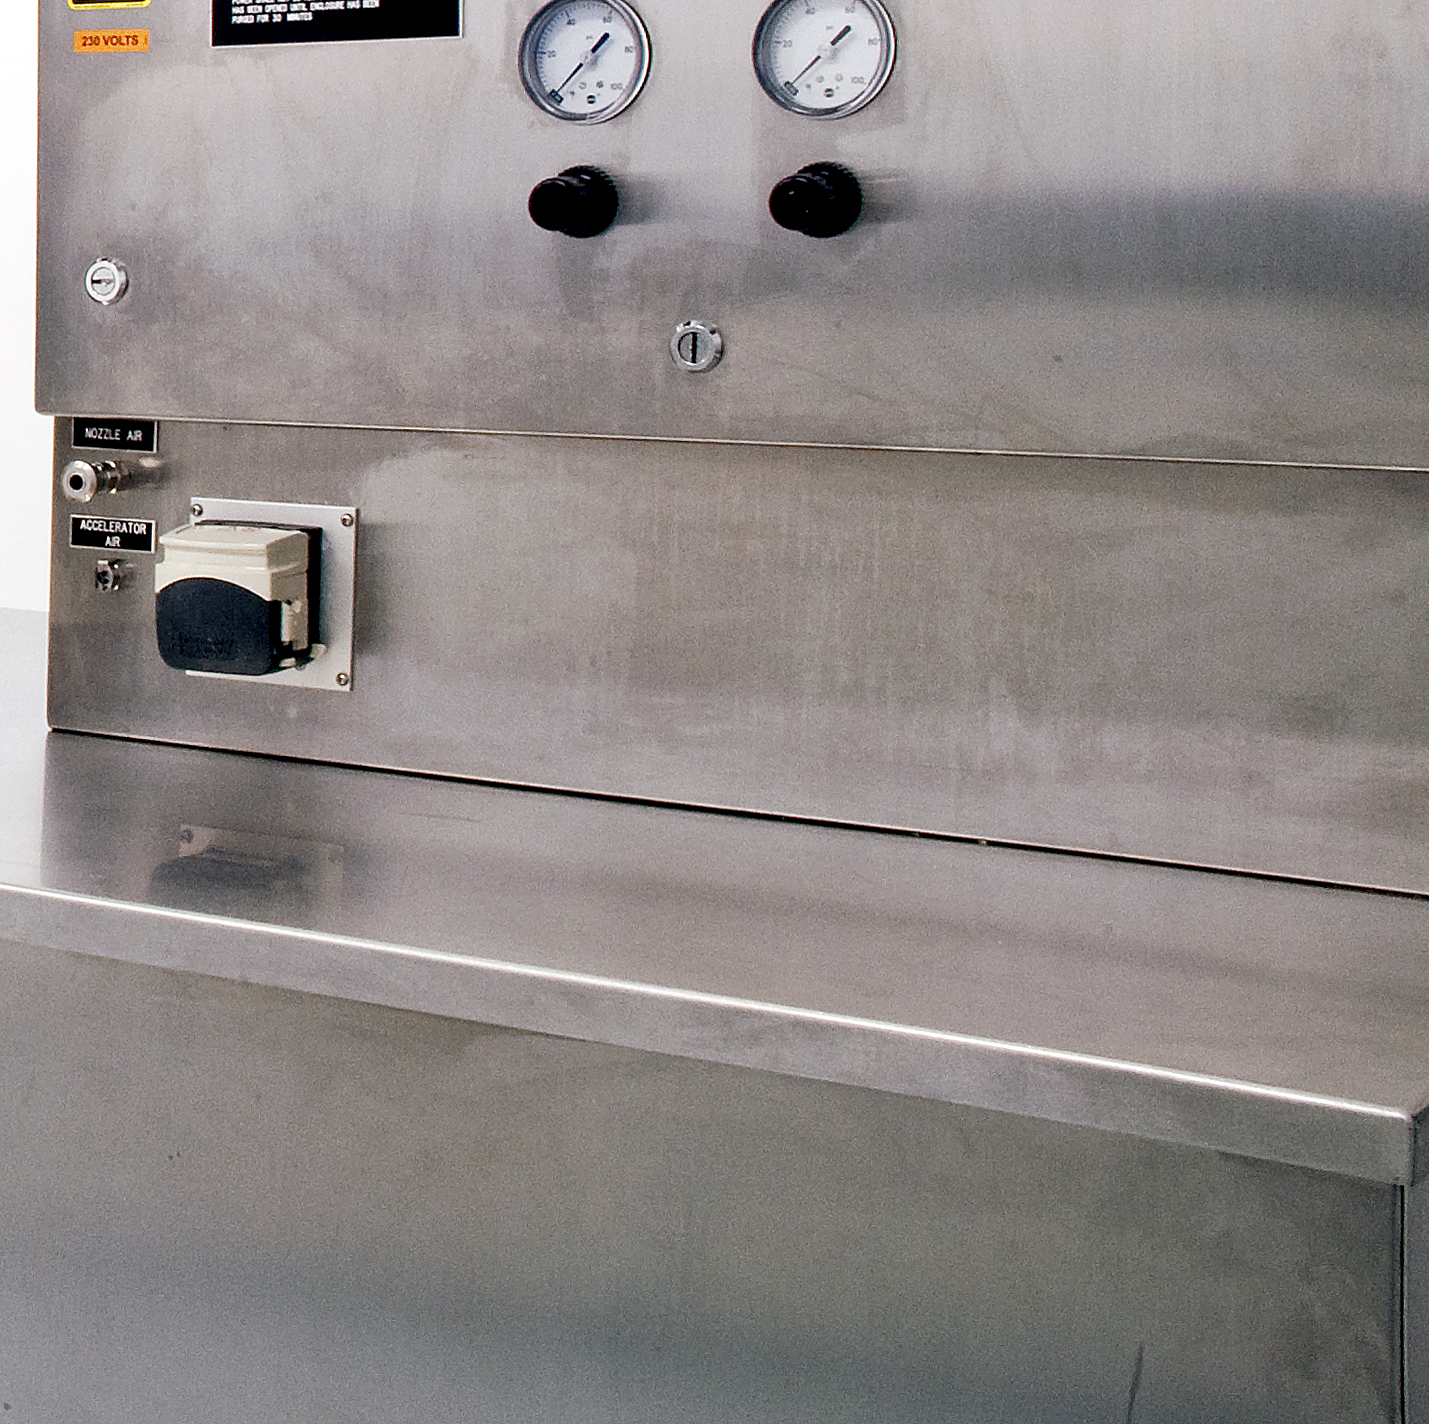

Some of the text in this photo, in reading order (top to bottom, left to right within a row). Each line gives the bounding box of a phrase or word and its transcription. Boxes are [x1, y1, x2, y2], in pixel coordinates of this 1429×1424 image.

[102, 35, 139, 46] VOLTS
[782, 39, 793, 48] 20
[84, 427, 143, 442] NOZZLE AIR
[80, 519, 147, 535] ACCELERATOR
[105, 535, 121, 548] AIR
